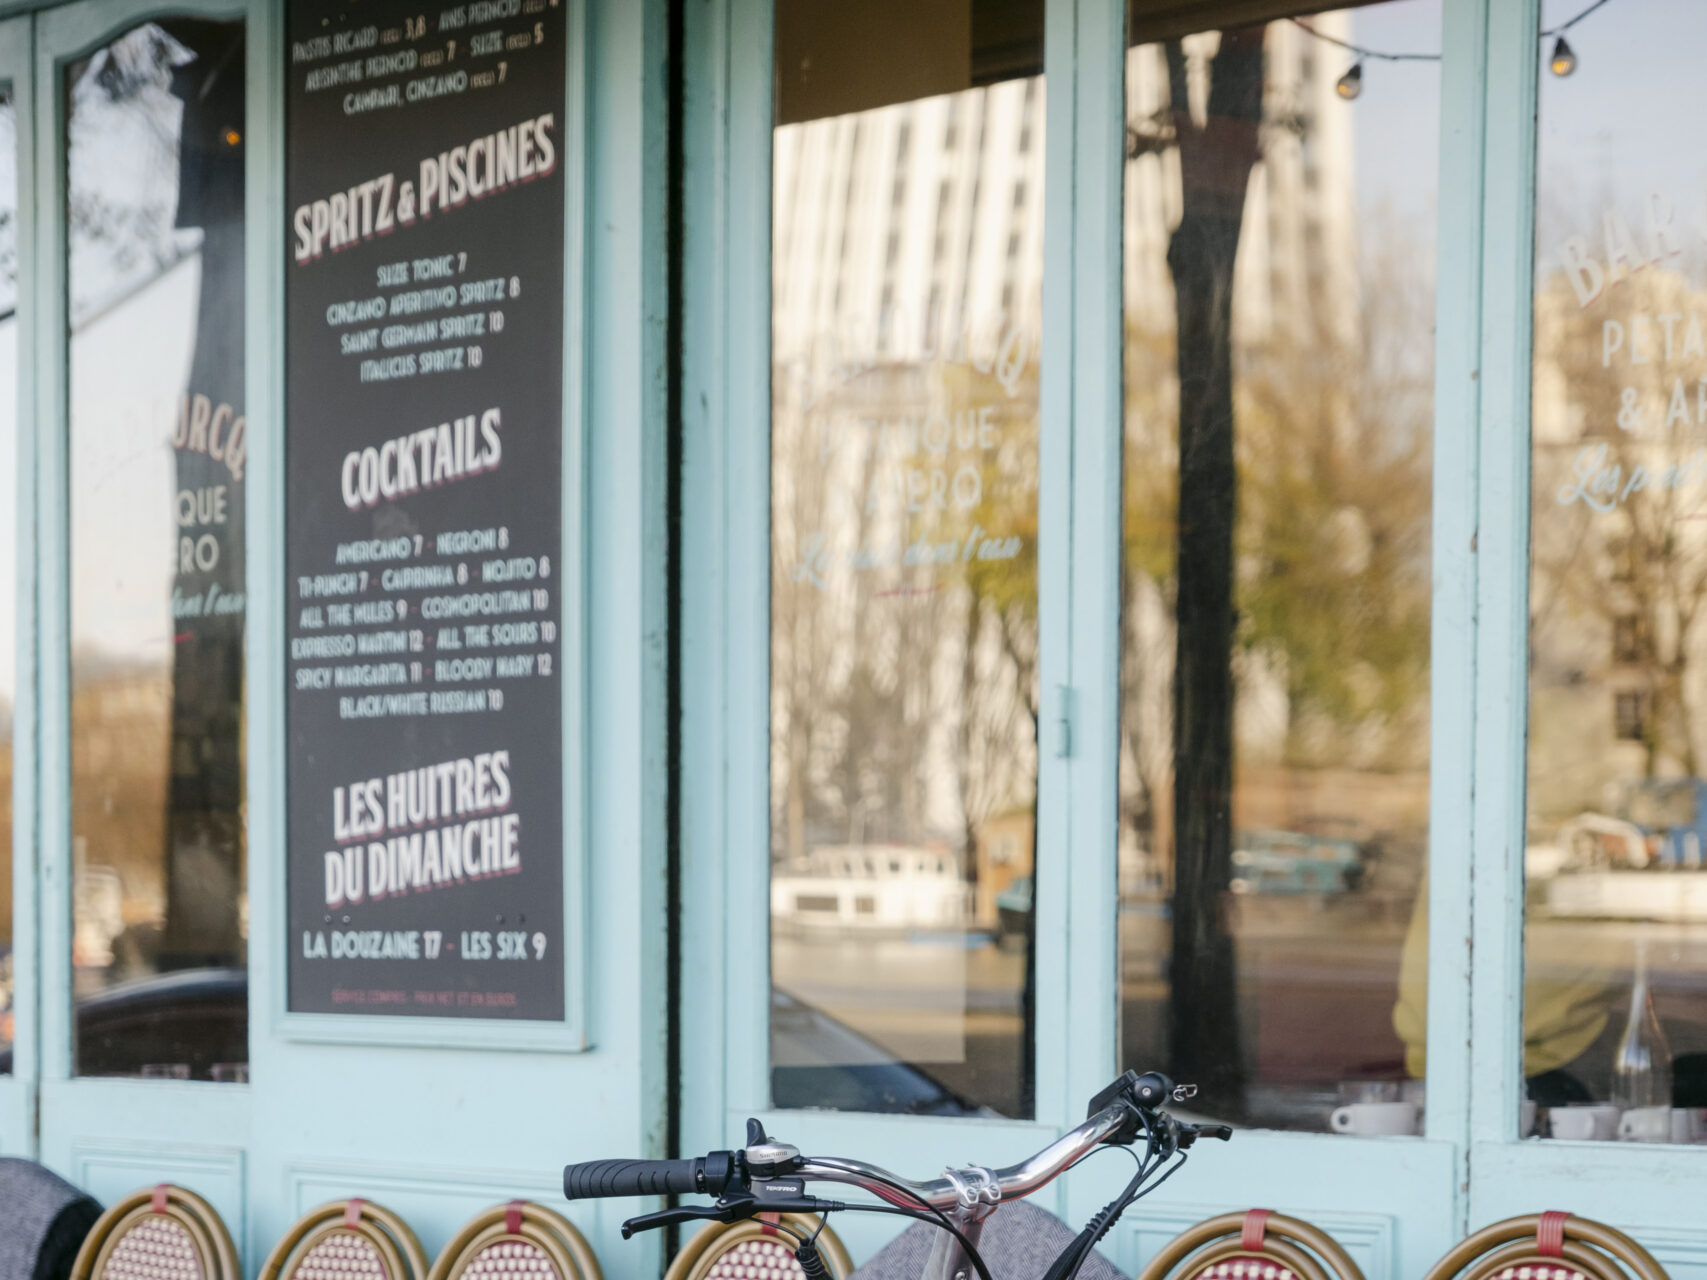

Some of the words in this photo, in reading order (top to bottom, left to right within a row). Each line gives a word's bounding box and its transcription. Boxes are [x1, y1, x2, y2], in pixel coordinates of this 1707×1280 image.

[333, 26, 379, 55] RICARD
[305, 61, 363, 93] ABSINTHE
[365, 49, 418, 79] PERNOD
[446, 40, 456, 62] 7
[470, 30, 503, 58] SUZE
[405, 70, 468, 102] CINZANO
[497, 62, 508, 84] 7
[294, 173, 396, 264] SPRITZ
[396, 181, 417, 226] &
[418, 113, 557, 219] PISCINES
[376, 262, 410, 287] SUZE
[412, 255, 455, 281] TONIC
[457, 252, 468, 274] 7
[326, 296, 387, 327] CINZANO
[459, 278, 506, 306] SPRITZ
[340, 328, 380, 355] SAINT
[381, 320, 439, 349] GERMAIN
[439, 313, 486, 341] SPRITZ
[488, 311, 505, 333] 10
[360, 354, 417, 382] ITALICUS
[418, 347, 465, 375] SPRITZ
[466, 346, 483, 369] 10
[1616, 386, 1644, 430] &
[341, 407, 502, 511] COCKTAILS
[335, 536, 411, 565] AMERICANO
[436, 528, 497, 556] NEGRONI
[481, 557, 537, 583] MOJITO
[299, 606, 325, 629] ALL
[326, 603, 352, 627] THE
[353, 600, 395, 625] MULES
[421, 589, 532, 620] COSMOPOLITAN
[532, 588, 549, 612] 10
[357, 630, 408, 656] MARTINI
[408, 629, 424, 653] 12
[436, 627, 463, 651] ALL
[463, 624, 491, 649] THE
[491, 622, 539, 647] SOURS
[539, 621, 556, 644] 10
[296, 667, 332, 690] SPICY
[334, 662, 408, 689] MARGARITA
[409, 662, 423, 685] 11
[434, 657, 494, 682] BLOODY
[495, 654, 535, 679] MARY
[536, 653, 552, 677] 12
[429, 689, 487, 715] RUSSIAN
[487, 689, 504, 712] 10
[333, 779, 386, 844] LES
[387, 751, 512, 832] HUITRES
[324, 845, 365, 910] DU
[367, 814, 521, 900] DIMANCHE
[303, 930, 329, 960] LA
[330, 931, 420, 960] DOUZAINE
[422, 931, 443, 960] 17
[460, 931, 493, 960] LES
[496, 932, 529, 960] SIX
[531, 932, 548, 960] 9
